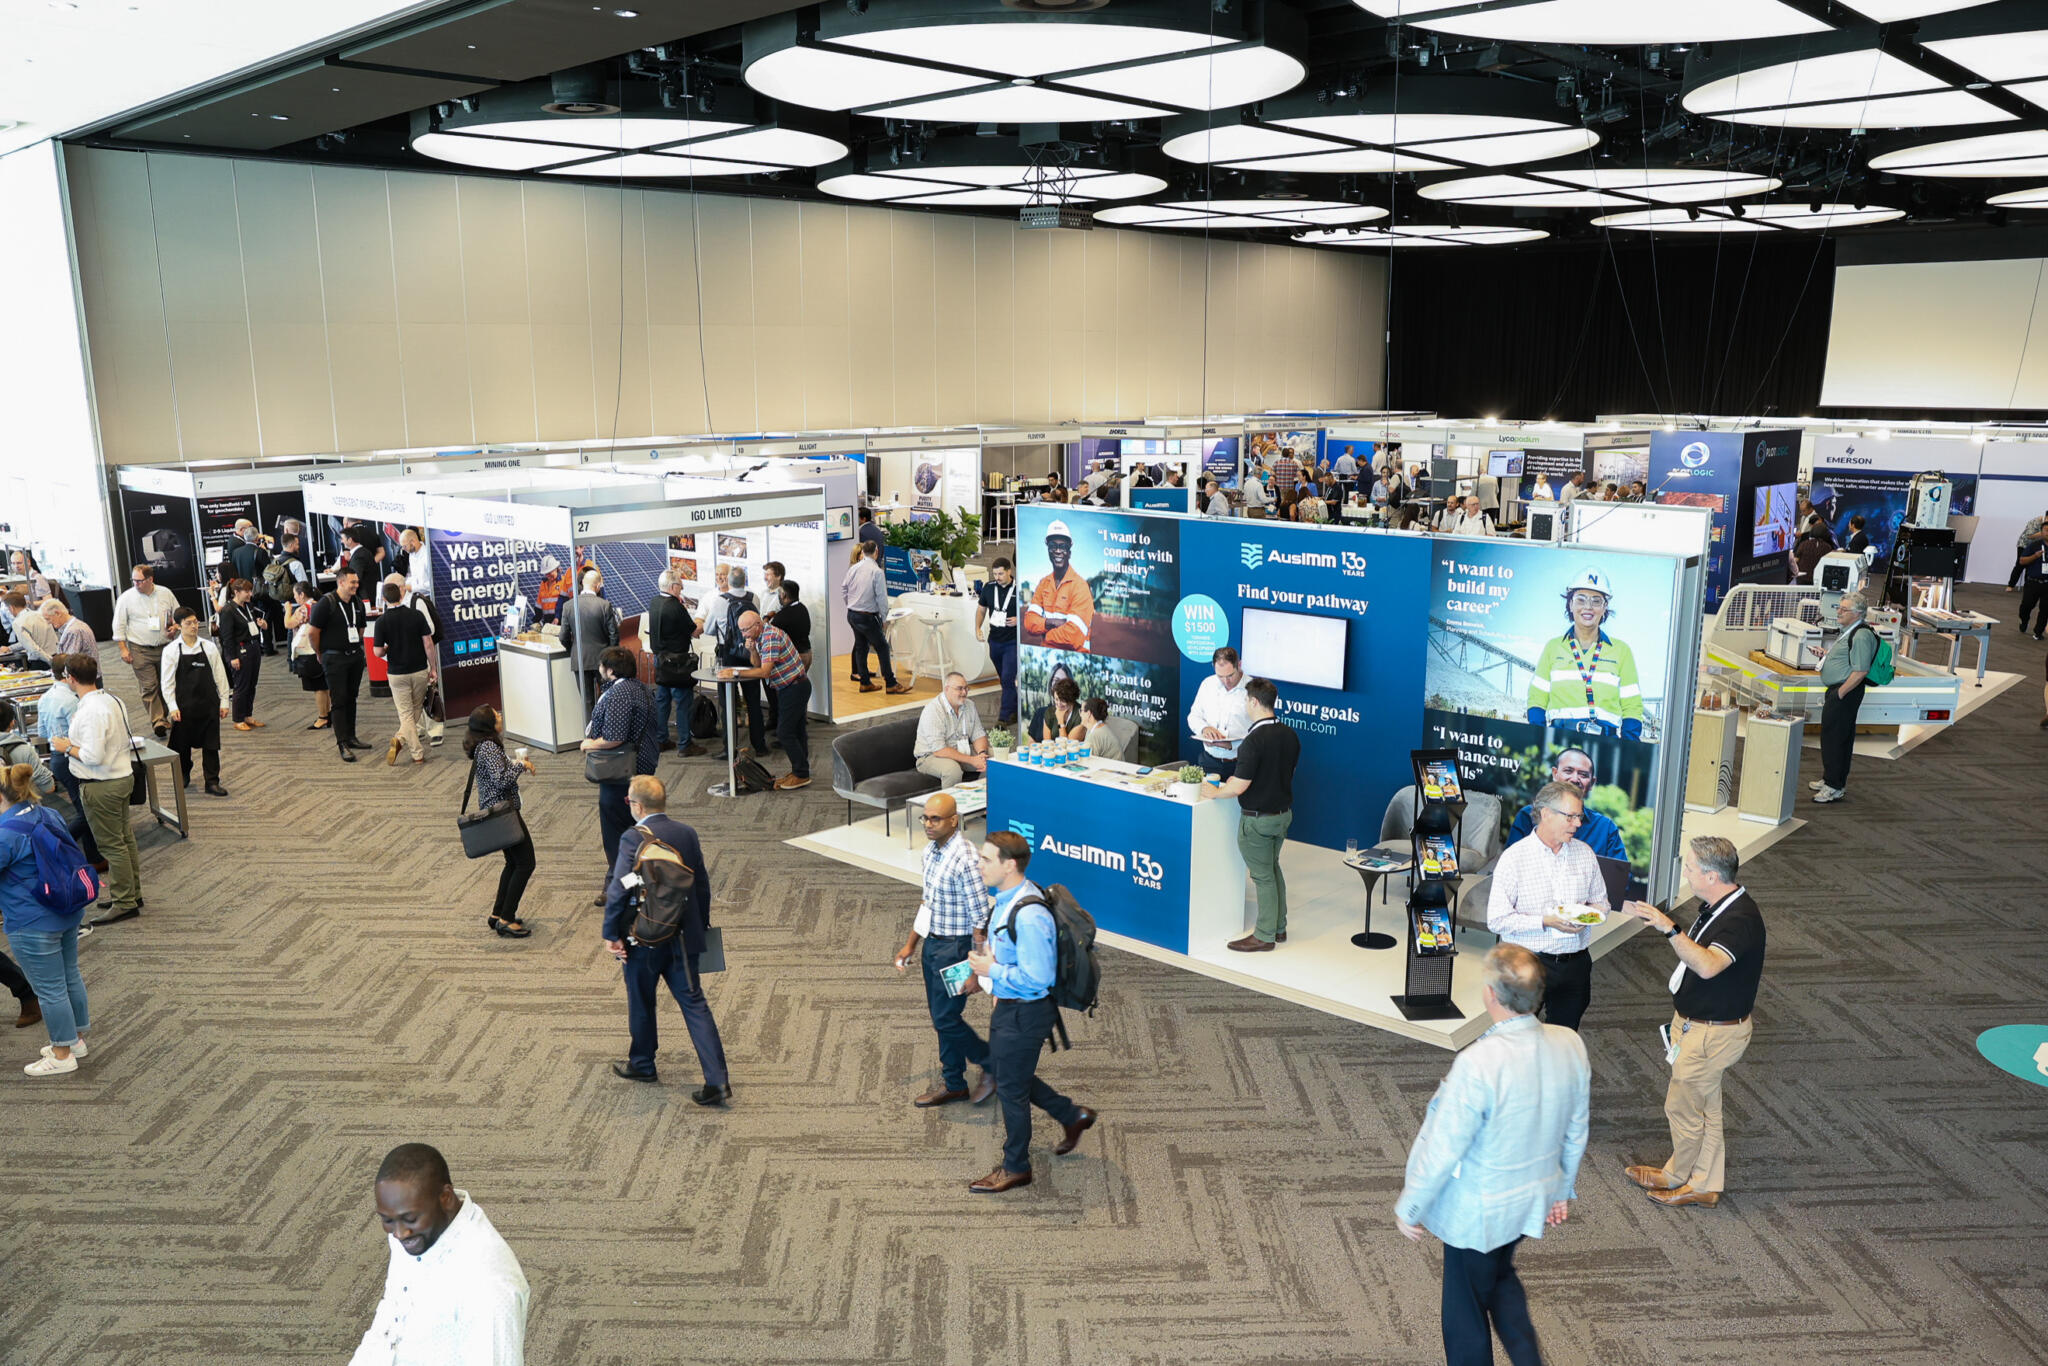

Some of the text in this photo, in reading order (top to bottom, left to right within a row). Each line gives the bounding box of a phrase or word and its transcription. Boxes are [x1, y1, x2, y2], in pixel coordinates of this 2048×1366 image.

[1498, 434, 1540, 443] Lycopodium
[484, 460, 520, 469] MINING ONE
[1826, 457, 1872, 465] EMERSON
[298, 473, 324, 482] SCIAPS
[407, 466, 411, 474] 8
[198, 481, 203, 489] 7
[691, 506, 742, 522] IGO LIMITED
[578, 522, 589, 533] 27
[785, 522, 819, 530] FFERENCE
[1110, 532, 1136, 544] want
[1139, 533, 1150, 545] to
[447, 540, 546, 560] We believe
[1104, 547, 1173, 564] connect with
[1341, 551, 1366, 570] 130
[450, 559, 538, 581] in a clean
[1104, 560, 1155, 578] industry”
[1442, 560, 1514, 579] “I want to
[451, 581, 515, 601] energy
[1448, 579, 1510, 600] build my
[1238, 584, 1368, 615] Find your pathway
[1446, 600, 1499, 615] career”
[453, 602, 510, 622] future
[1184, 605, 1215, 620] WIN
[1185, 622, 1216, 633] $1500
[458, 658, 499, 668] IGO.COM.A
[1112, 674, 1138, 686] want
[1140, 677, 1152, 688] to
[1105, 685, 1167, 708] broaden my
[1284, 701, 1318, 714] your
[1320, 706, 1360, 723] goals
[1276, 715, 1337, 735] simm.com
[1433, 726, 1503, 749] “I want to
[1456, 747, 1520, 773] hance my
[1461, 766, 1484, 780] lls”
[1131, 851, 1163, 880] 130
[1133, 876, 1162, 890] YEARS
